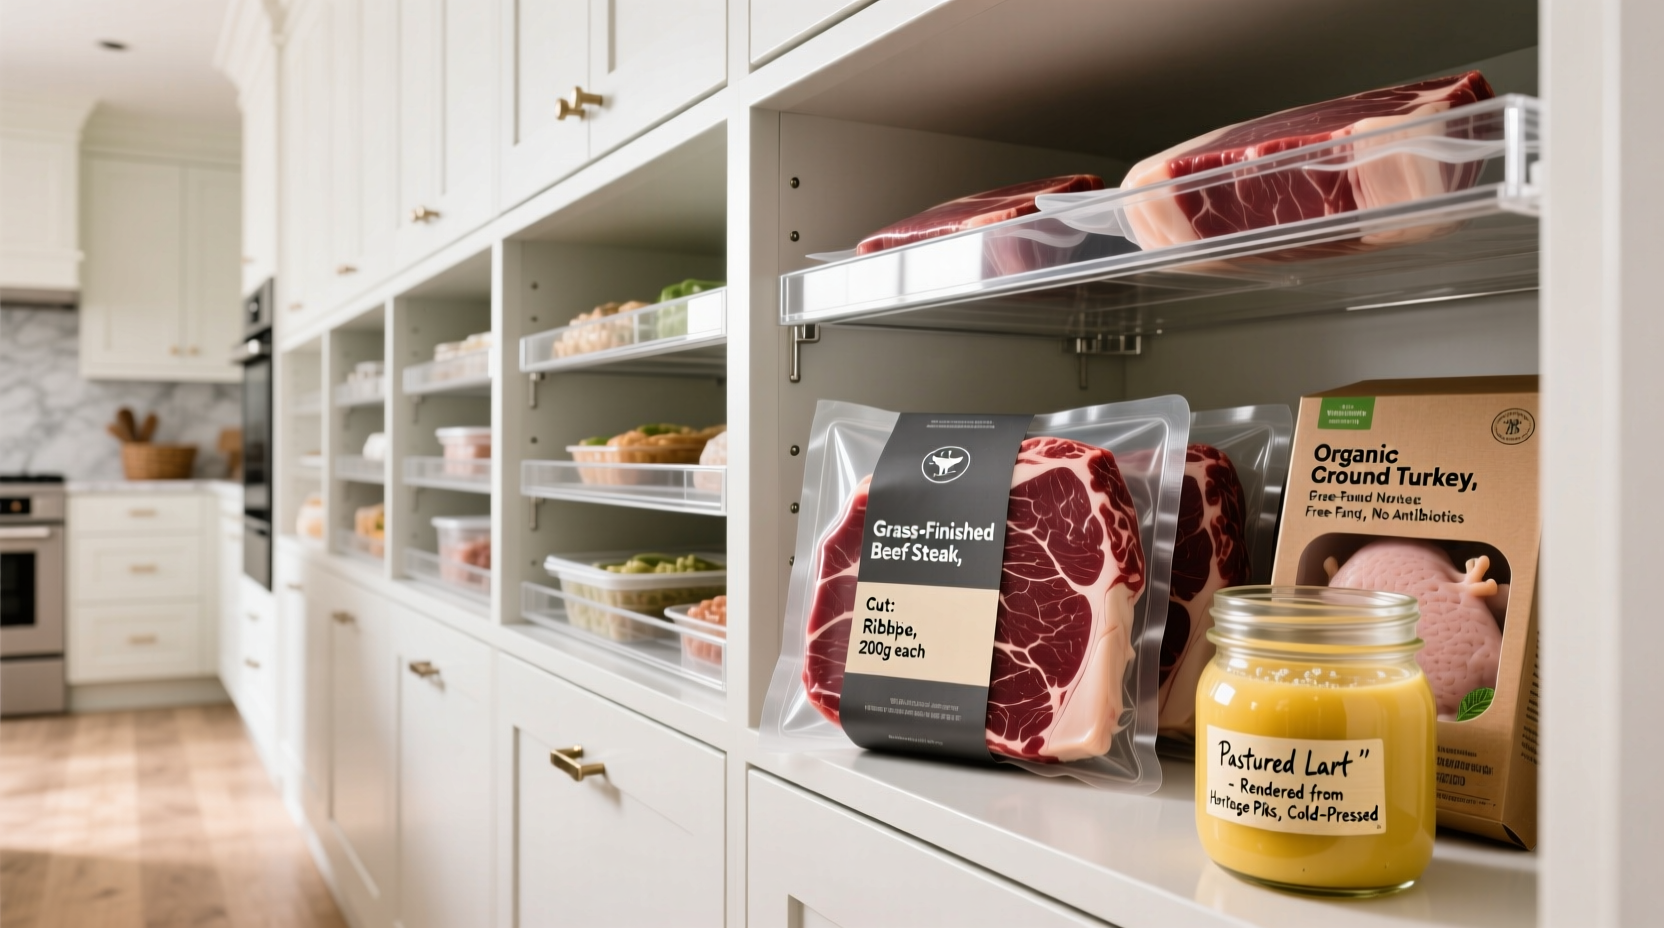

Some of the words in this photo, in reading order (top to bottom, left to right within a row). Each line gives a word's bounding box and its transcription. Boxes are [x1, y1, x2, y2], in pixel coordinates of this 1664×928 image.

[1313, 443, 1399, 467] Organic
[1397, 466, 1478, 493] Turkey,
[1372, 507, 1390, 520] No
[872, 519, 995, 541] Grass-Finished
[870, 542, 911, 561] Beef
[911, 544, 962, 567] Steak,
[866, 596, 895, 613] Cut:
[858, 640, 892, 661] 200g
[894, 643, 926, 659] each
[1218, 740, 1297, 775] Pastured
[1240, 777, 1305, 800] Rendered
[1308, 784, 1344, 802] from
[1287, 804, 1379, 823] Cold-Pressed
